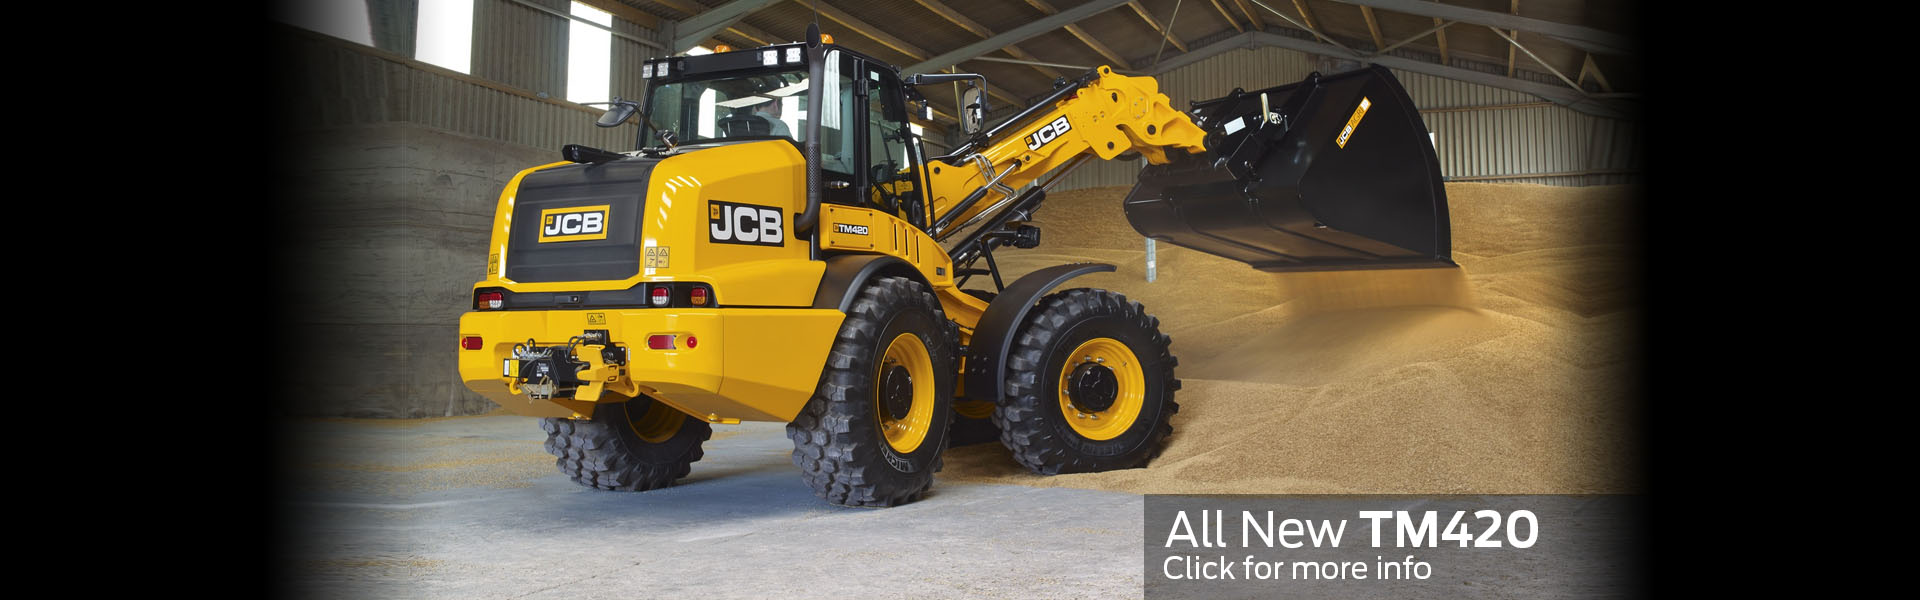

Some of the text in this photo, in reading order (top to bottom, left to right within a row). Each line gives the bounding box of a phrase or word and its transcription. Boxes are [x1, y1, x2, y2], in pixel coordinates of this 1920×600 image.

[1028, 116, 1071, 151] JCB
[1340, 125, 1353, 145] JCB
[545, 212, 603, 236] JCB
[711, 205, 783, 243] JCB
[838, 224, 869, 236] TM420
